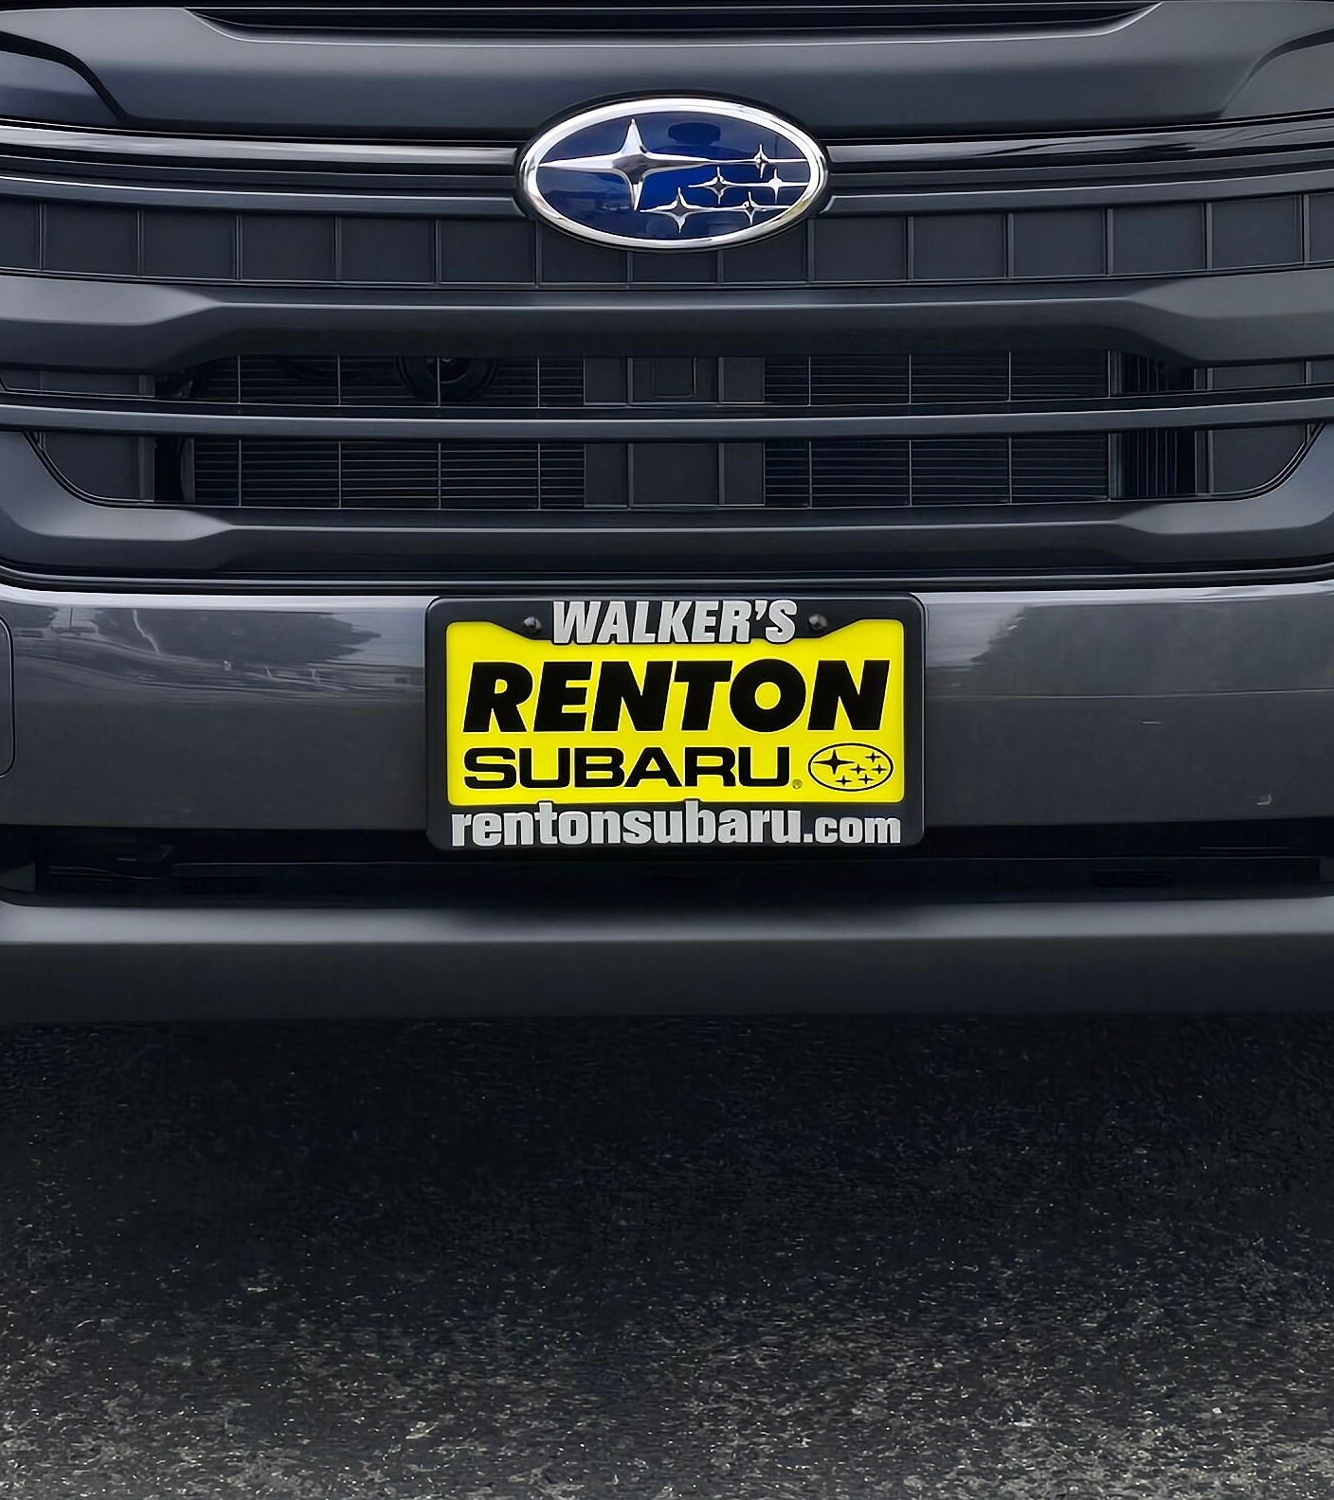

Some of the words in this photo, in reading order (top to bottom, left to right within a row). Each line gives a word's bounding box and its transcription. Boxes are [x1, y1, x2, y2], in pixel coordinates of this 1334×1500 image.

[552, 599, 797, 644] WALKER'S
[463, 659, 890, 732] RENTON
[463, 746, 790, 789] SUBARU
[451, 799, 901, 847] rentonsubaru.com
